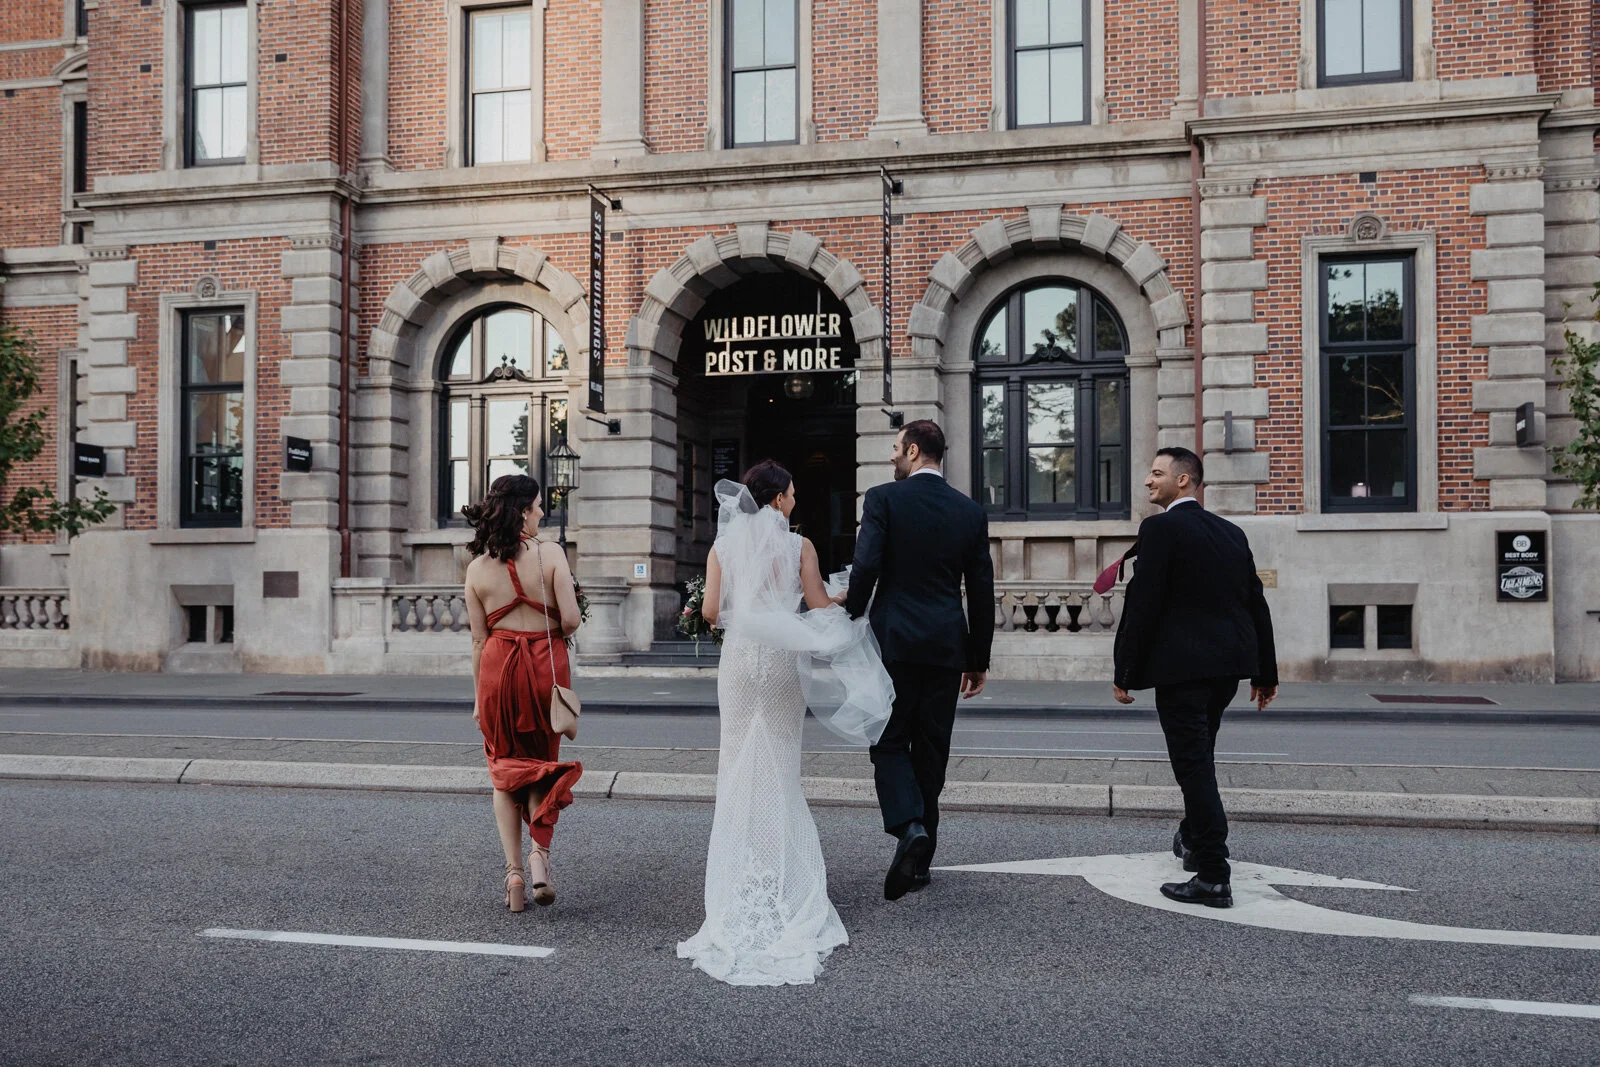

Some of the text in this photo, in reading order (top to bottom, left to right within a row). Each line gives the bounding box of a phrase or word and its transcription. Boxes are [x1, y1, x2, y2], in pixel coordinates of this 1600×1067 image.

[593, 211, 602, 360] STATE BUILDINGS
[704, 313, 841, 341] WILDFLOWER
[705, 347, 841, 373] POST & MORE
